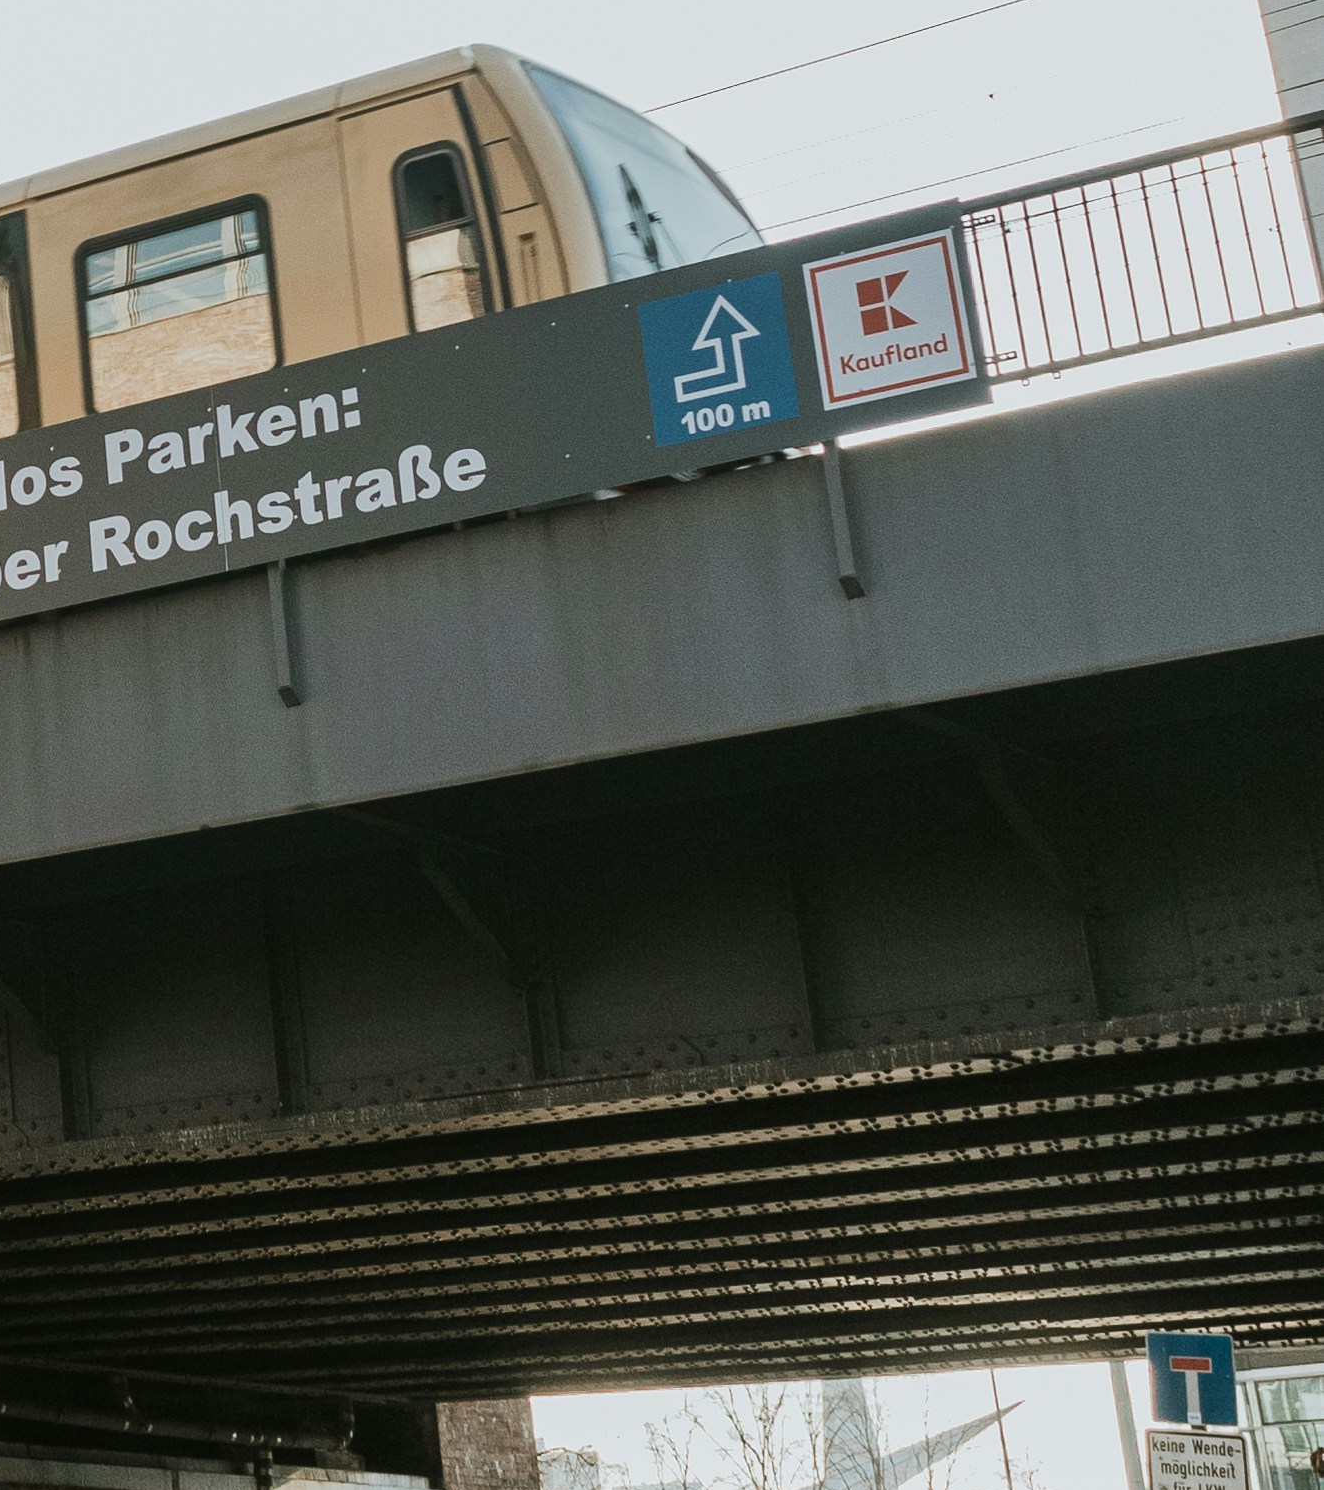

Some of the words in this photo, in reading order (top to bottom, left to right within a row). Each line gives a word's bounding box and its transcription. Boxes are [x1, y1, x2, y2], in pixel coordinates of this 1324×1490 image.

[840, 333, 948, 374] Kaufland
[104, 386, 361, 485] Parken:
[681, 402, 734, 434] 100
[742, 401, 770, 421] m
[88, 443, 487, 573] Rochstraße
[1152, 1437, 1185, 1454] keine
[1192, 1438, 1242, 1457] Wende-
[1160, 1459, 1236, 1480] möglichkeit
